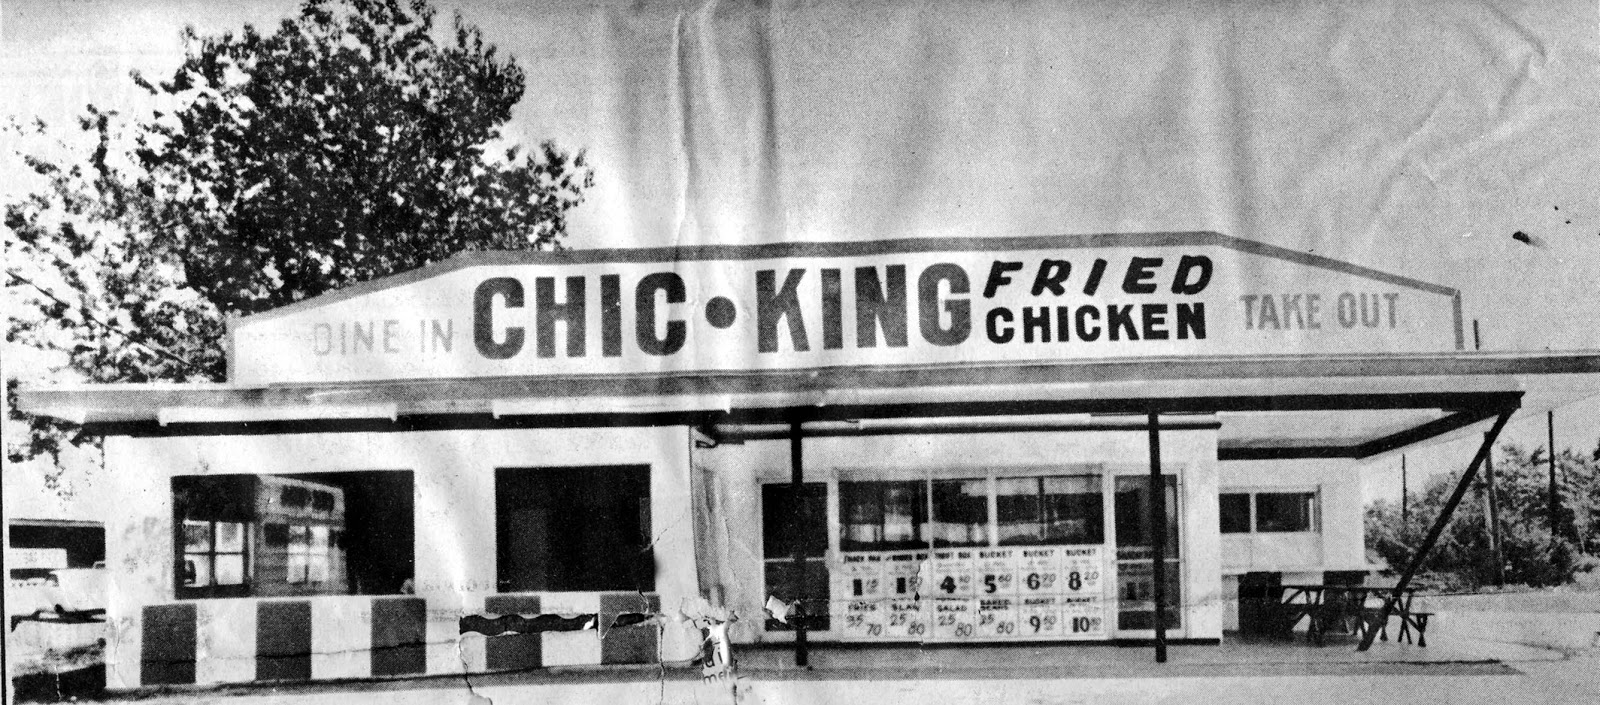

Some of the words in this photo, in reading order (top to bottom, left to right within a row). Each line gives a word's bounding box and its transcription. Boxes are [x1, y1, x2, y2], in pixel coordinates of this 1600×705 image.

[982, 254, 1214, 298] FRIED
[473, 271, 687, 360] CHIC
[755, 262, 972, 354] KING
[985, 302, 1207, 345] CHICKEN
[1239, 293, 1322, 331] TAKE
[1337, 292, 1400, 330] OUT
[313, 319, 400, 357] DINE
[420, 318, 454, 354] IN
[979, 550, 1013, 559] BUCKET
[1023, 549, 1055, 558] BUCKET
[1065, 548, 1097, 557] BUCKET
